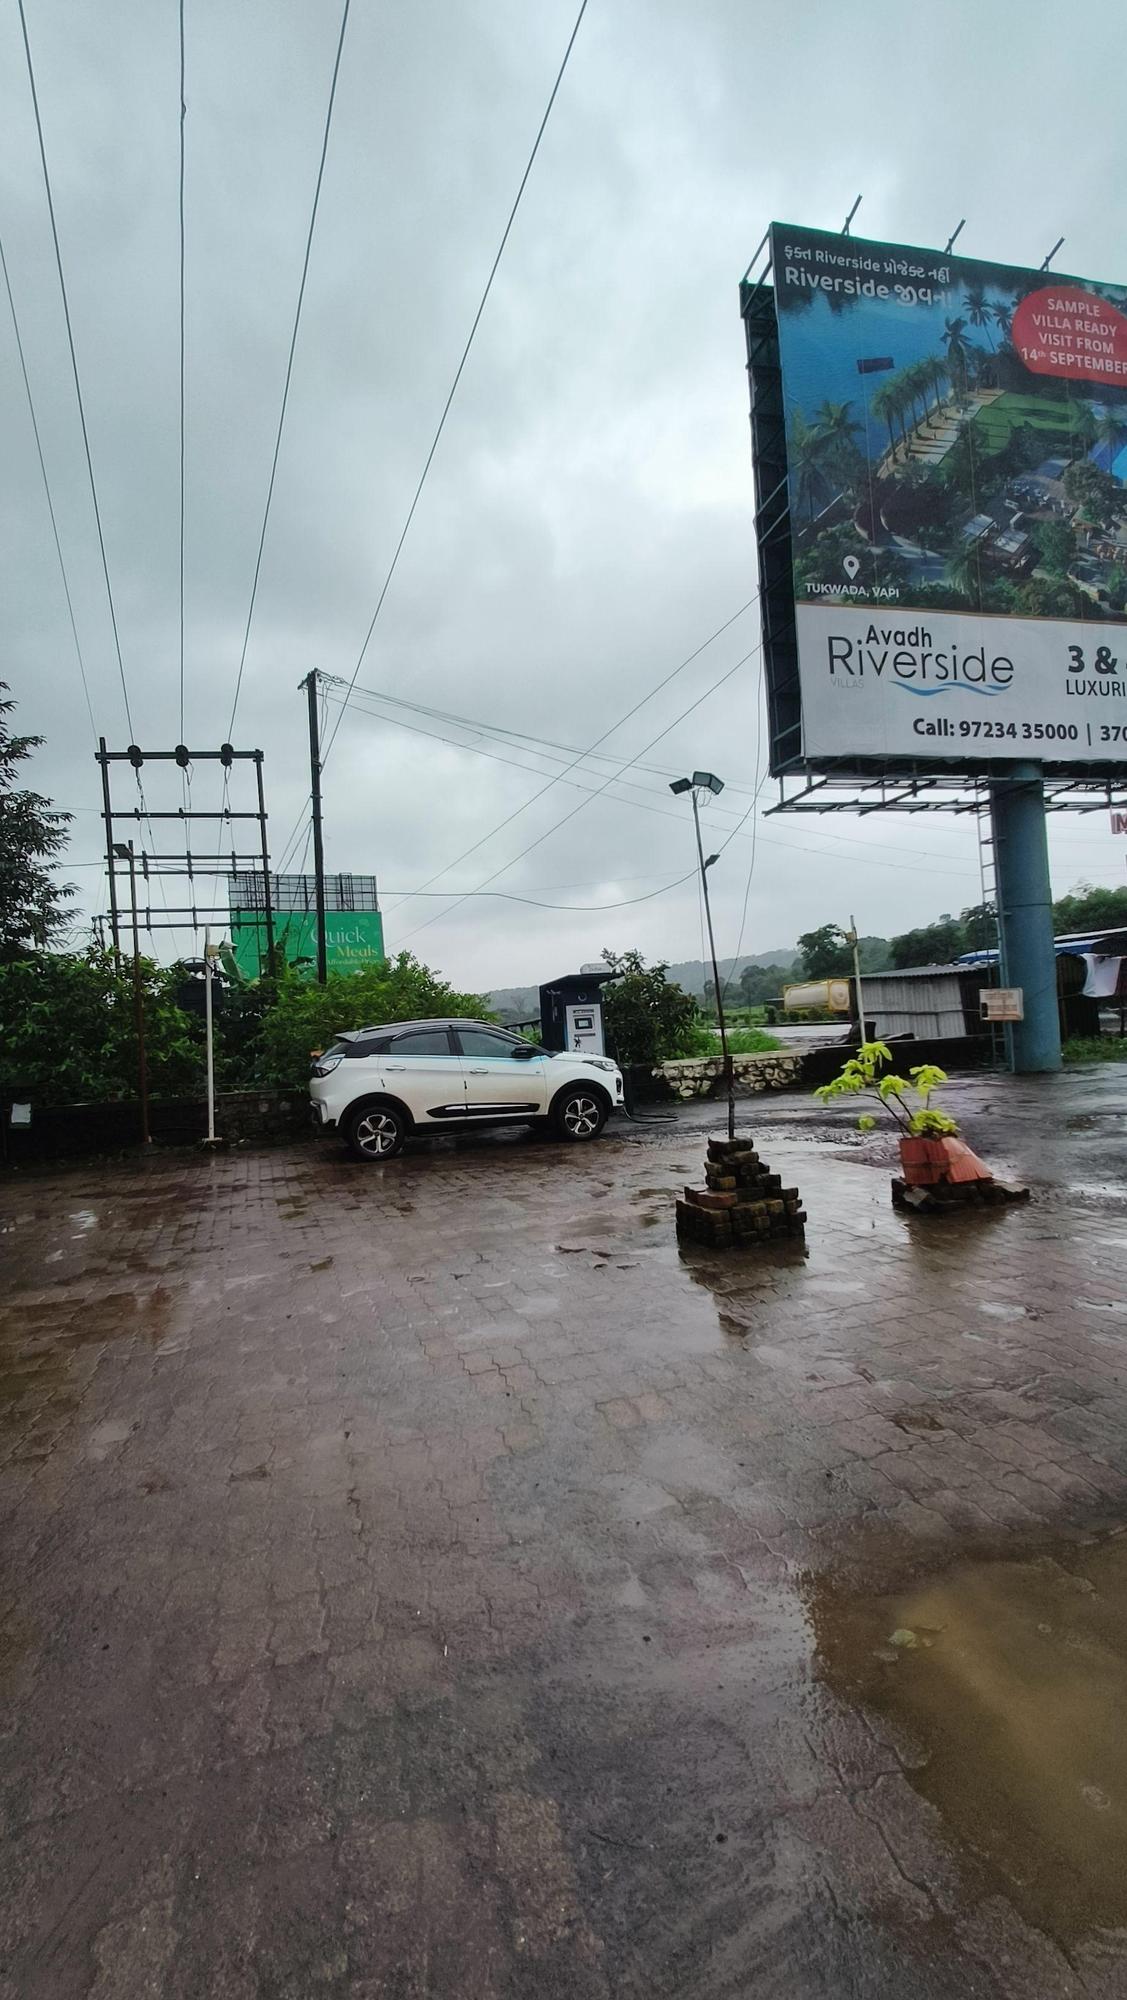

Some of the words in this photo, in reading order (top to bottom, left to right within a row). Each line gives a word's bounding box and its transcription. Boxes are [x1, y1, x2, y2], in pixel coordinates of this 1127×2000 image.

[784, 245, 812, 261] ફક્ત
[816, 250, 881, 272] Riverside
[883, 259, 925, 279] પ્રોજેક્ટ
[785, 266, 889, 299] Riverside
[1047, 298, 1100, 317] SAMPLE
[1032, 314, 1072, 330] VILLA
[1075, 319, 1117, 337] READY
[1038, 332, 1073, 347] VISIT
[1076, 337, 1115, 354] FROM
[1021, 347, 1046, 361] 14th
[1050, 351, 1127, 375] SEPTEMBER
[805, 583, 869, 598] TUKWADA,
[872, 586, 899, 598] VAPI
[865, 624, 932, 648] Avadh
[827, 636, 1014, 684] Riverside
[1068, 645, 1085, 673] 3
[1094, 646, 1118, 675] &
[830, 677, 864, 689] VILLAS
[912, 718, 954, 737] Call:
[959, 720, 1017, 739] 97234
[1021, 723, 1078, 740] 35000
[310, 926, 366, 948] Quick
[336, 945, 379, 957] Meals
